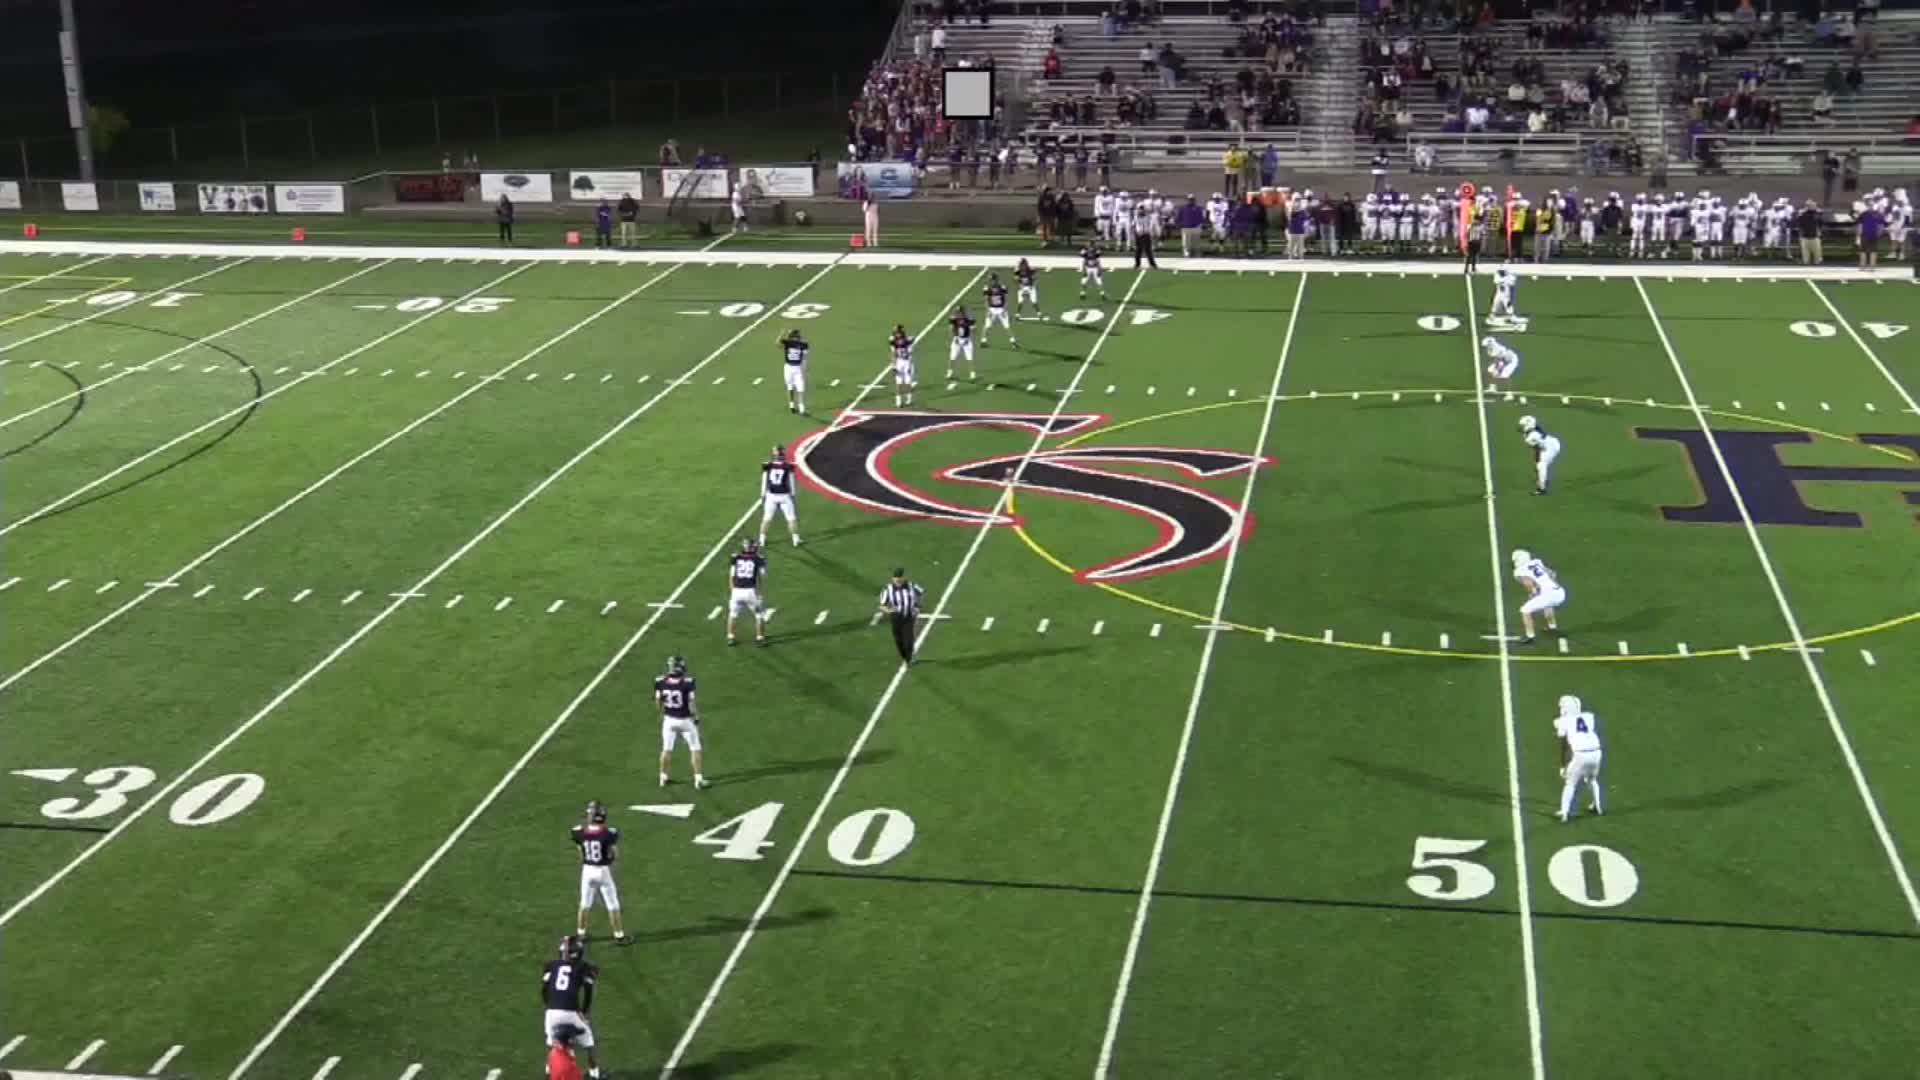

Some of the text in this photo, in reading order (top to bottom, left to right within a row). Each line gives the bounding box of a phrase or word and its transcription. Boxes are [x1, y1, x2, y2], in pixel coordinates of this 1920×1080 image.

[720, 303, 831, 319] 30
[1060, 308, 1174, 324] 40
[1789, 320, 1909, 339] 40
[769, 468, 784, 486] 47
[663, 690, 683, 708] 33
[1576, 717, 1588, 734] 4
[40, 765, 265, 826] 30
[691, 801, 915, 866] 40
[583, 841, 602, 863] 18
[1406, 836, 1639, 907] 50
[555, 966, 571, 991] 6
